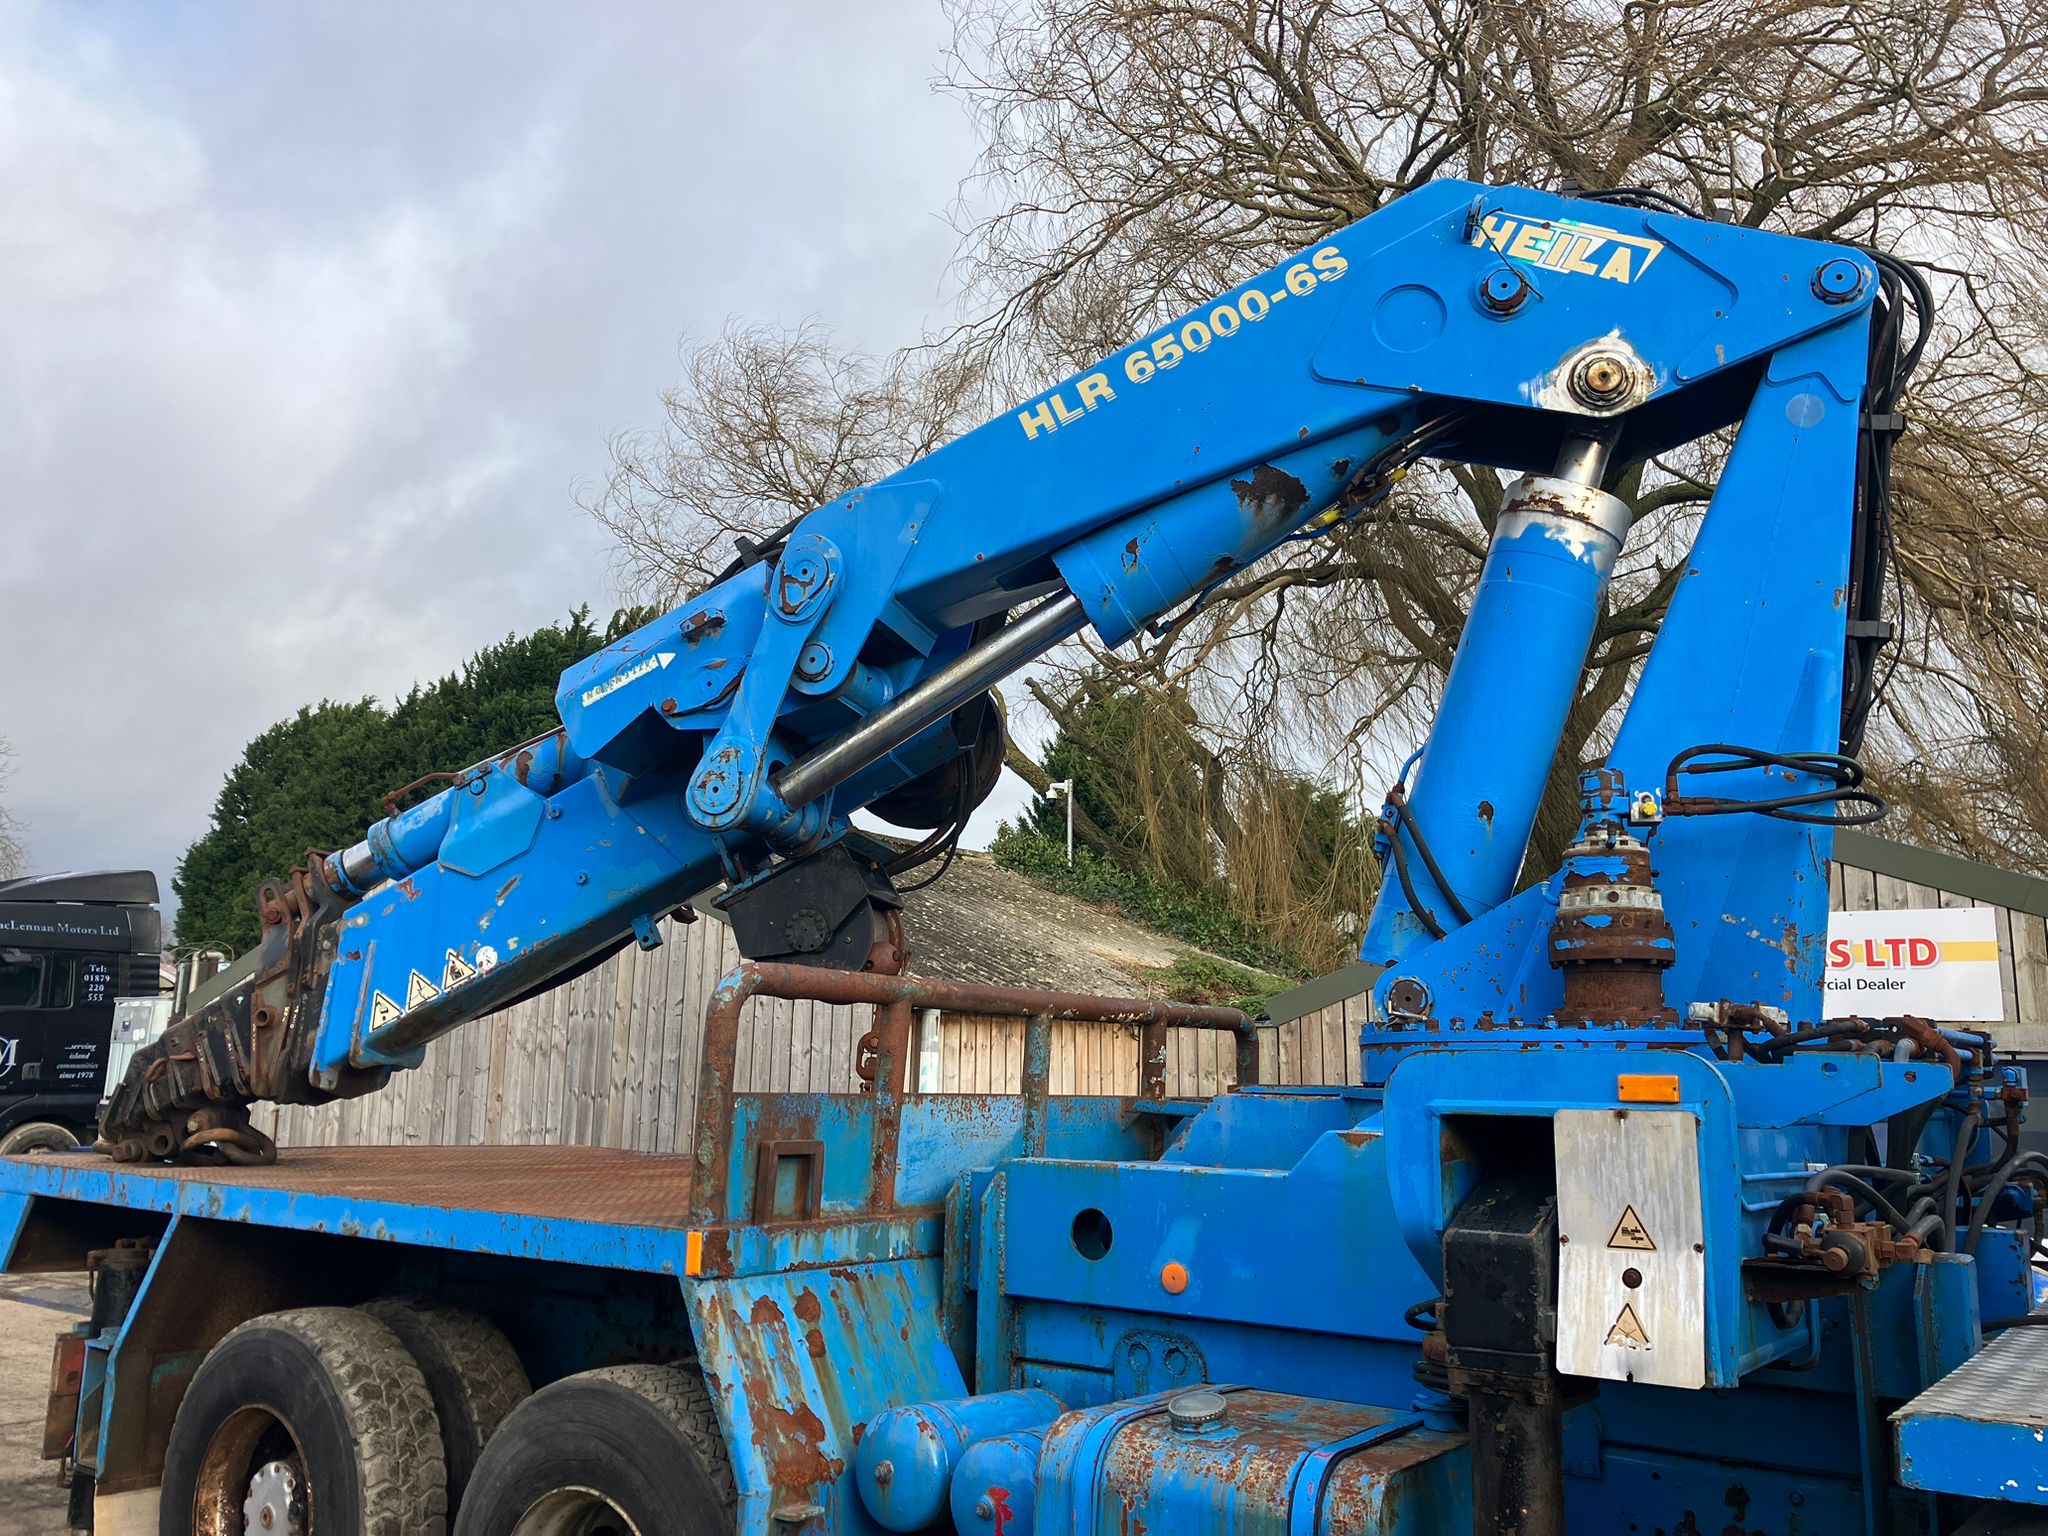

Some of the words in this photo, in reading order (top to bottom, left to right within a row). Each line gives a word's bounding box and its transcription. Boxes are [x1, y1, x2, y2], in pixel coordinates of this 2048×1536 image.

[1472, 216, 1631, 284] HEILA
[1018, 372, 1117, 440] HLR
[1125, 246, 1348, 384] 65000-6S
[57, 922, 98, 935] Motors
[100, 925, 119, 936] Ltd
[1826, 938, 1851, 968] S
[1865, 938, 1937, 968] LTD
[88, 964, 107, 973] Tel:
[83, 974, 111, 982] 01879
[88, 983, 105, 992] 220
[1856, 978, 1906, 990] Dealer
[87, 993, 104, 1001] 555
[77, 1071, 94, 1079] 1978
